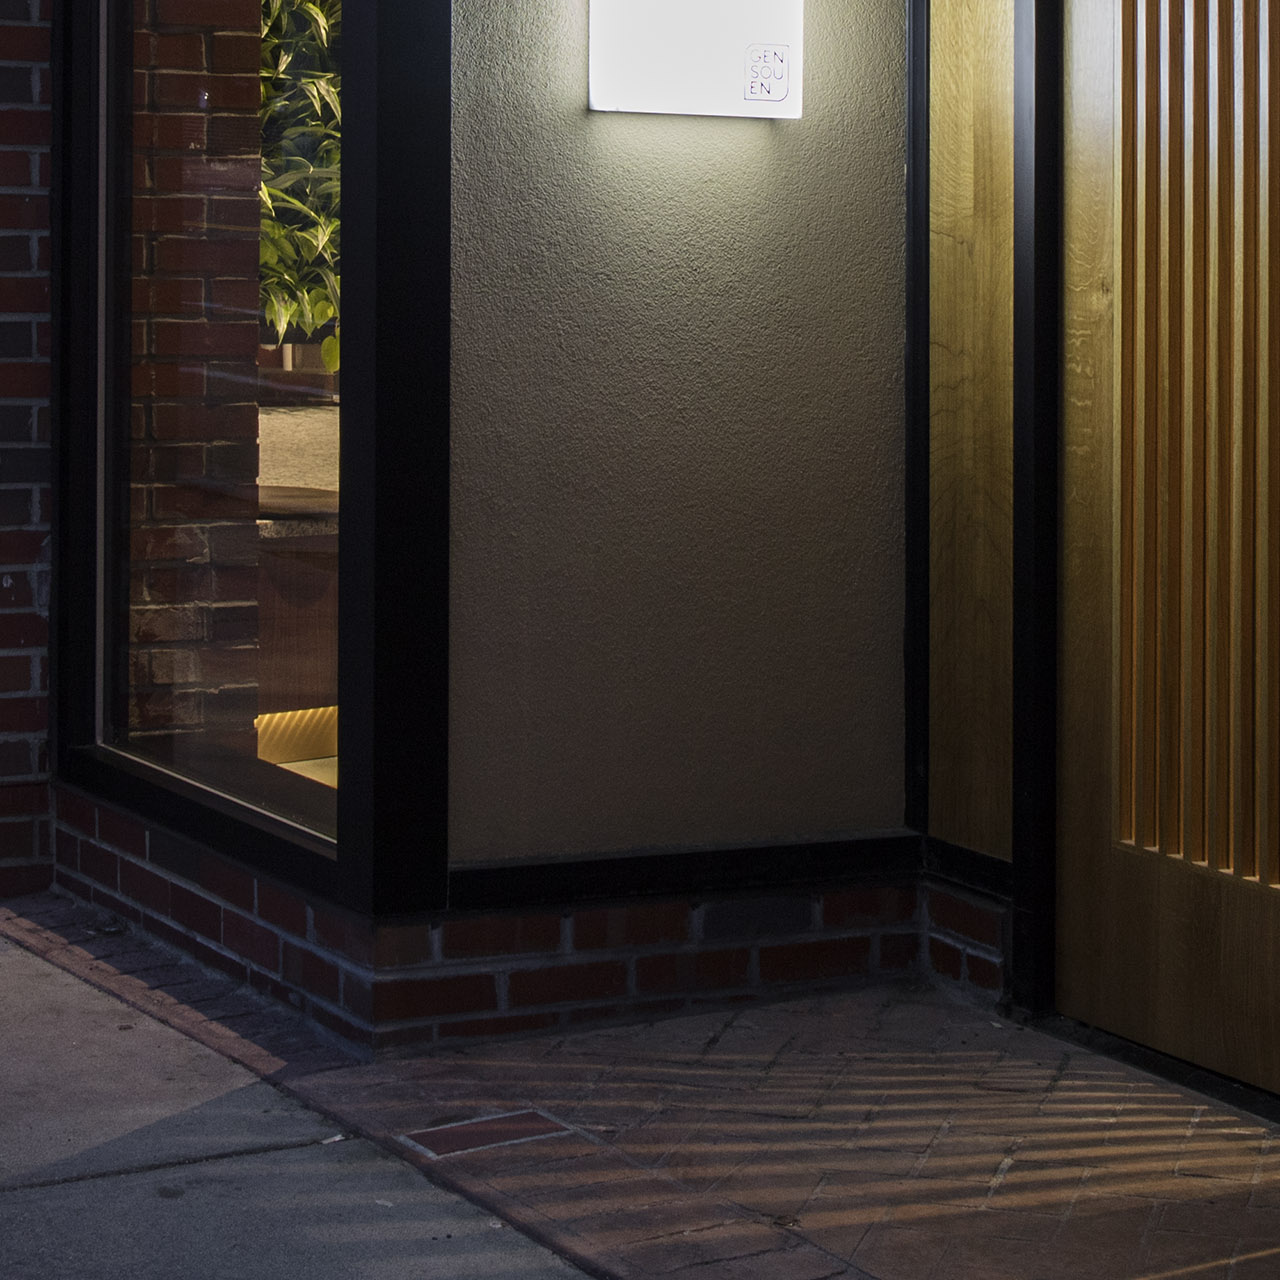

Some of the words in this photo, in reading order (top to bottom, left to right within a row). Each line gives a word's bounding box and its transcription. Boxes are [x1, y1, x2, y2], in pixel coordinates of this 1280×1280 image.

[750, 49, 784, 63] GEN
[750, 65, 784, 80] SOU
[750, 81, 770, 95] EN
